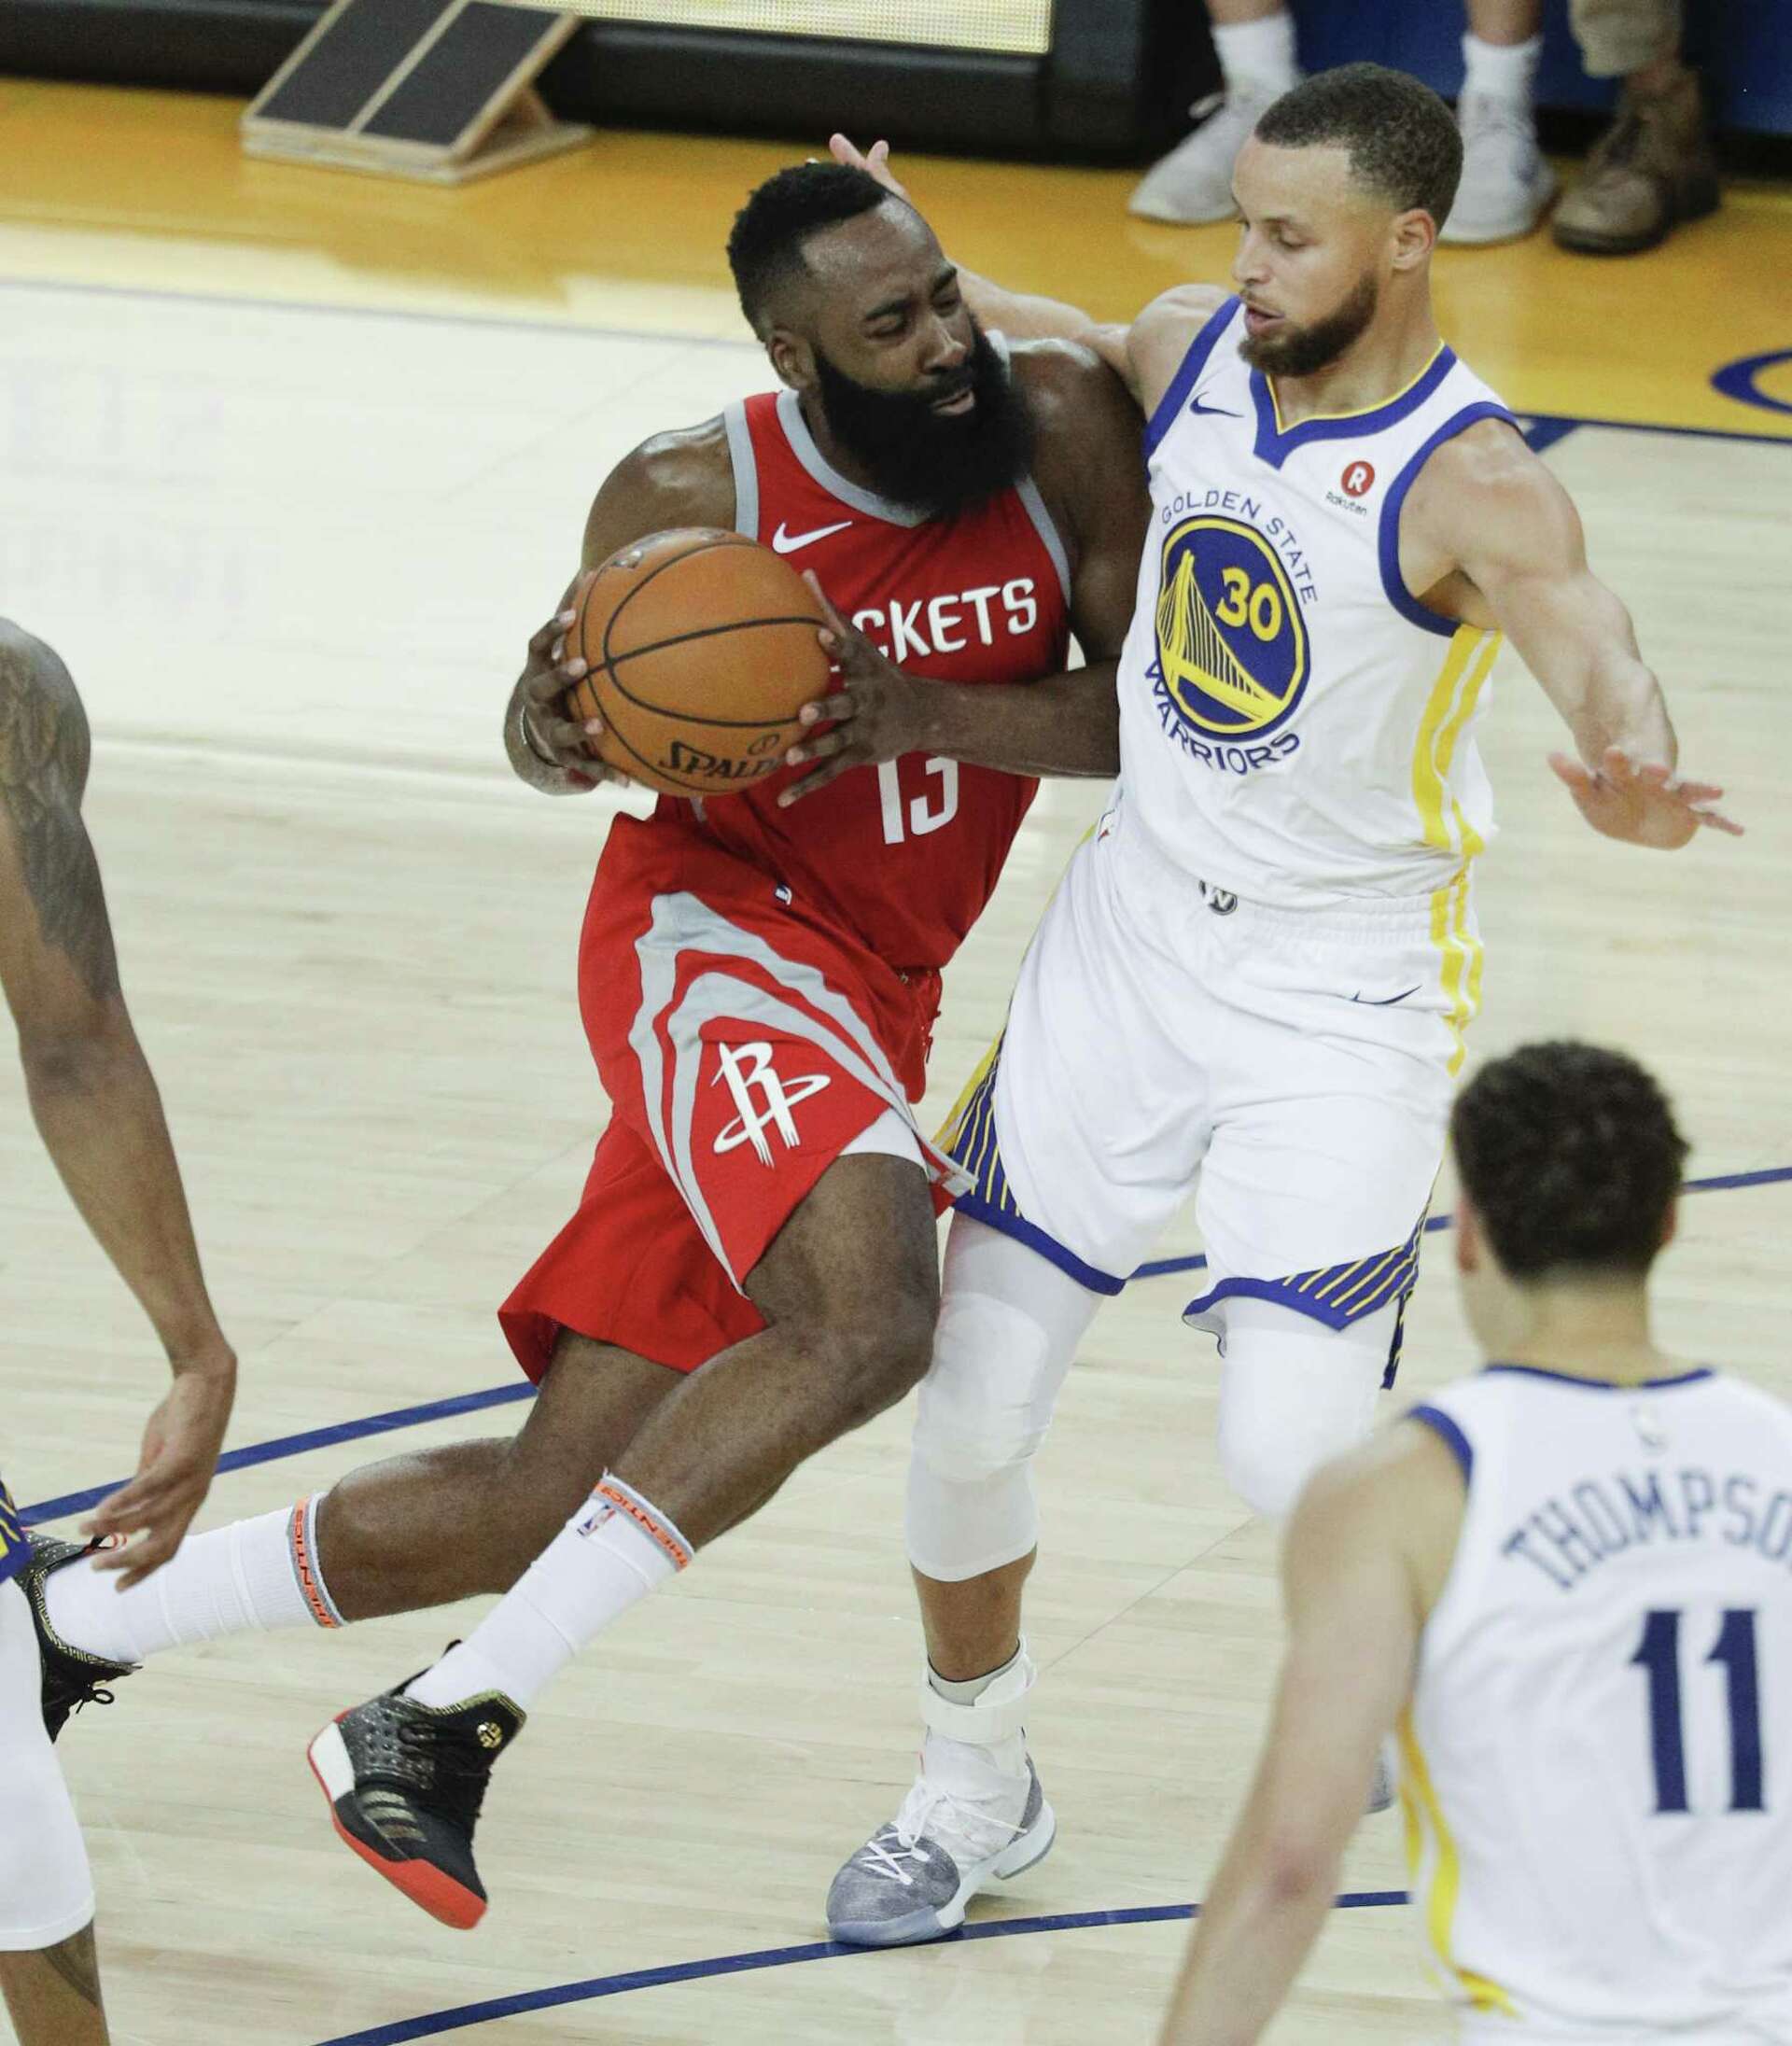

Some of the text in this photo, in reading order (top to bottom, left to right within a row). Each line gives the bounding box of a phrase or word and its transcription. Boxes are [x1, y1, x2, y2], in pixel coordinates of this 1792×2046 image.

[1160, 489, 1319, 605] GOLDEN STATE
[1325, 492, 1368, 516] Rakuten
[831, 577, 1038, 674] CKETS
[1215, 567, 1282, 642] 30
[658, 741, 782, 778] SPALD
[1144, 659, 1301, 776] WARRIORS
[876, 756, 959, 845] 13
[1503, 1467, 1792, 1591] THOMPSO
[1629, 1607, 1767, 1815] 11
